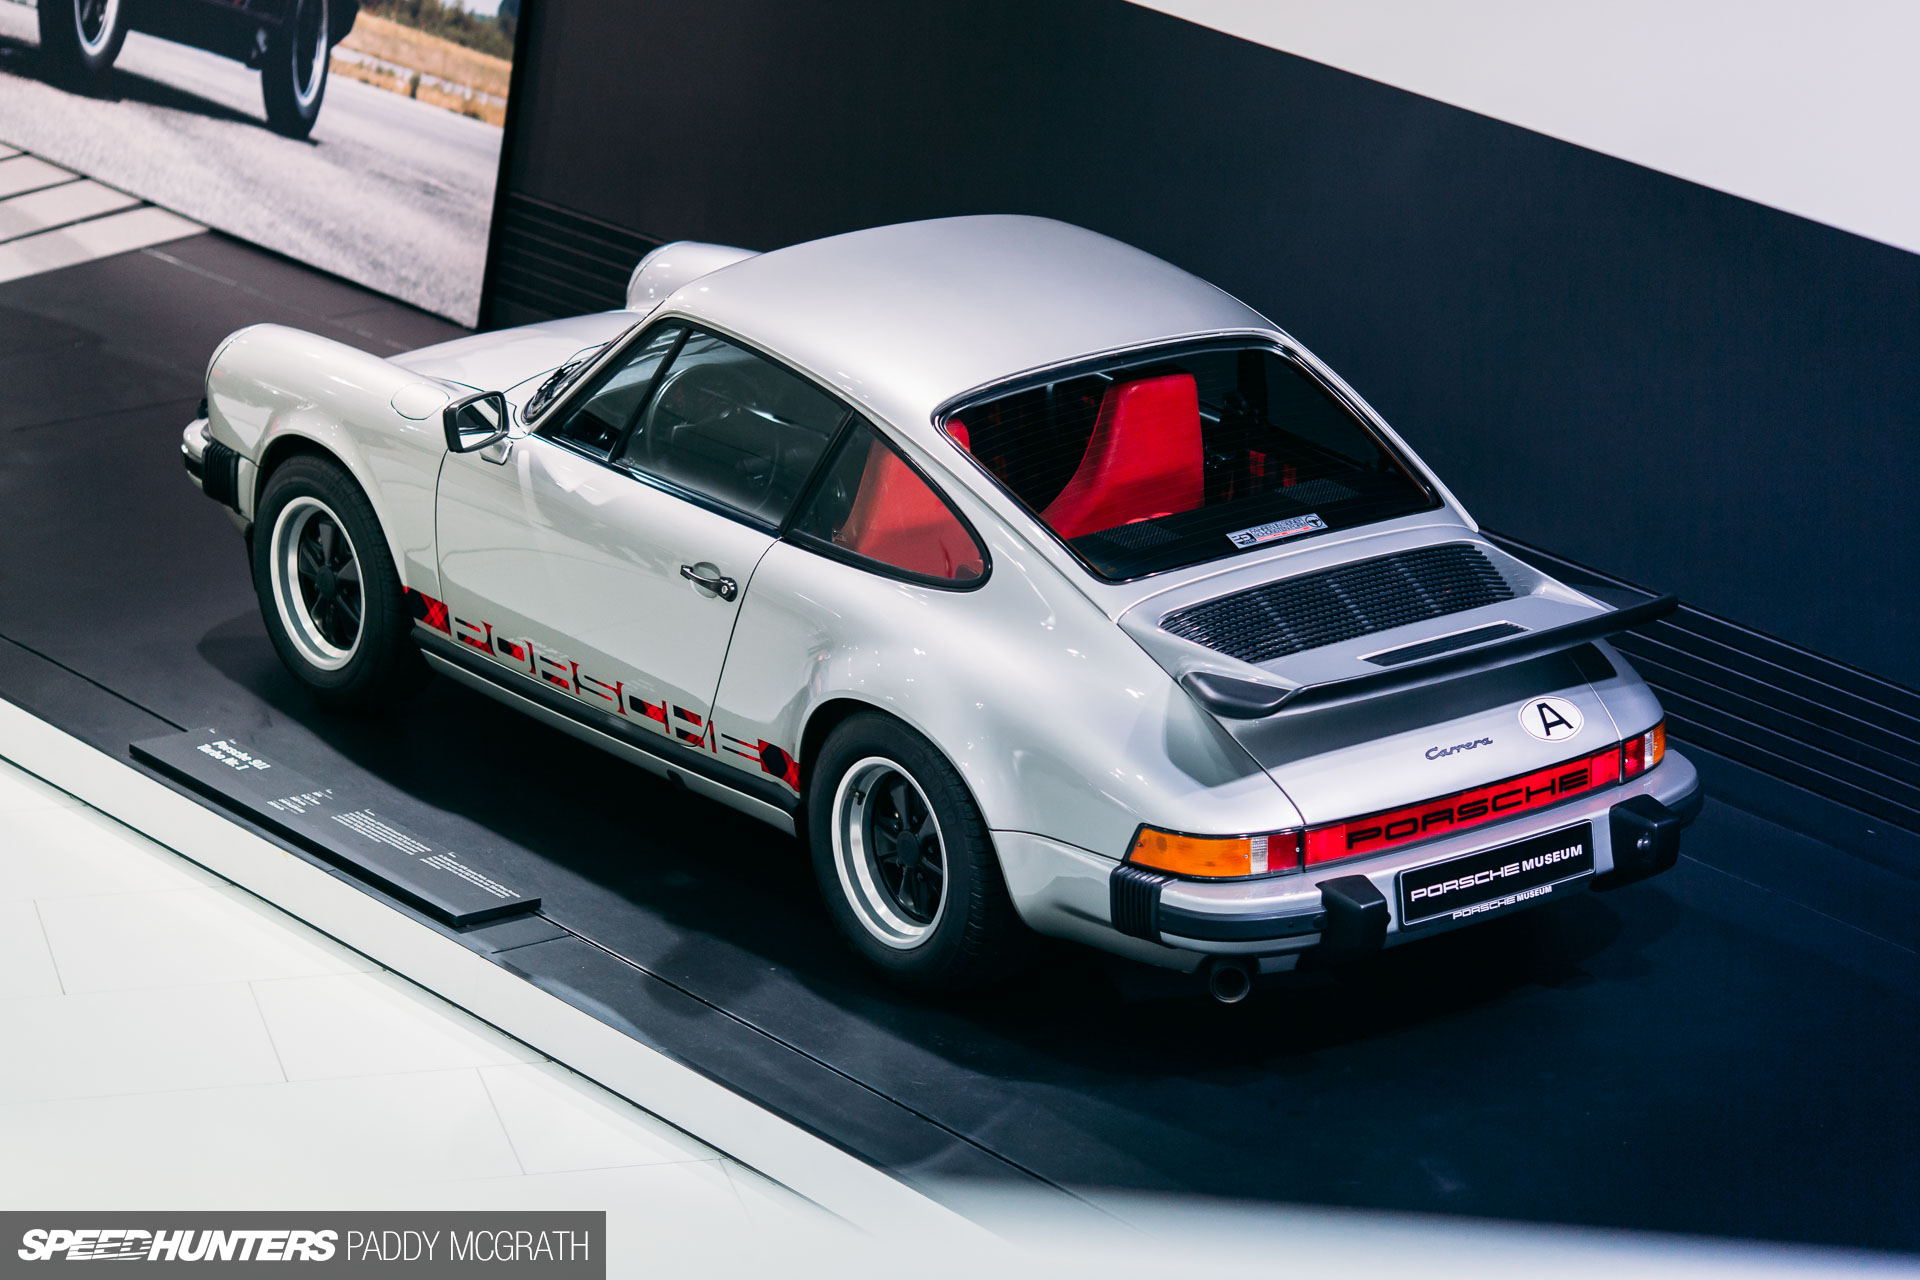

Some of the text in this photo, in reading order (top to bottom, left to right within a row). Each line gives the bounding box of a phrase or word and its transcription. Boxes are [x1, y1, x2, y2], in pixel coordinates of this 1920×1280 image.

[450, 610, 762, 766] PORSCHE
[1536, 702, 1575, 737] A
[1425, 737, 1494, 760] Carrera
[1347, 768, 1588, 850] PORSCHE
[1411, 844, 1583, 902] PORSCHE MUSEUM
[1452, 885, 1553, 920] PORSCHE MUSEUM
